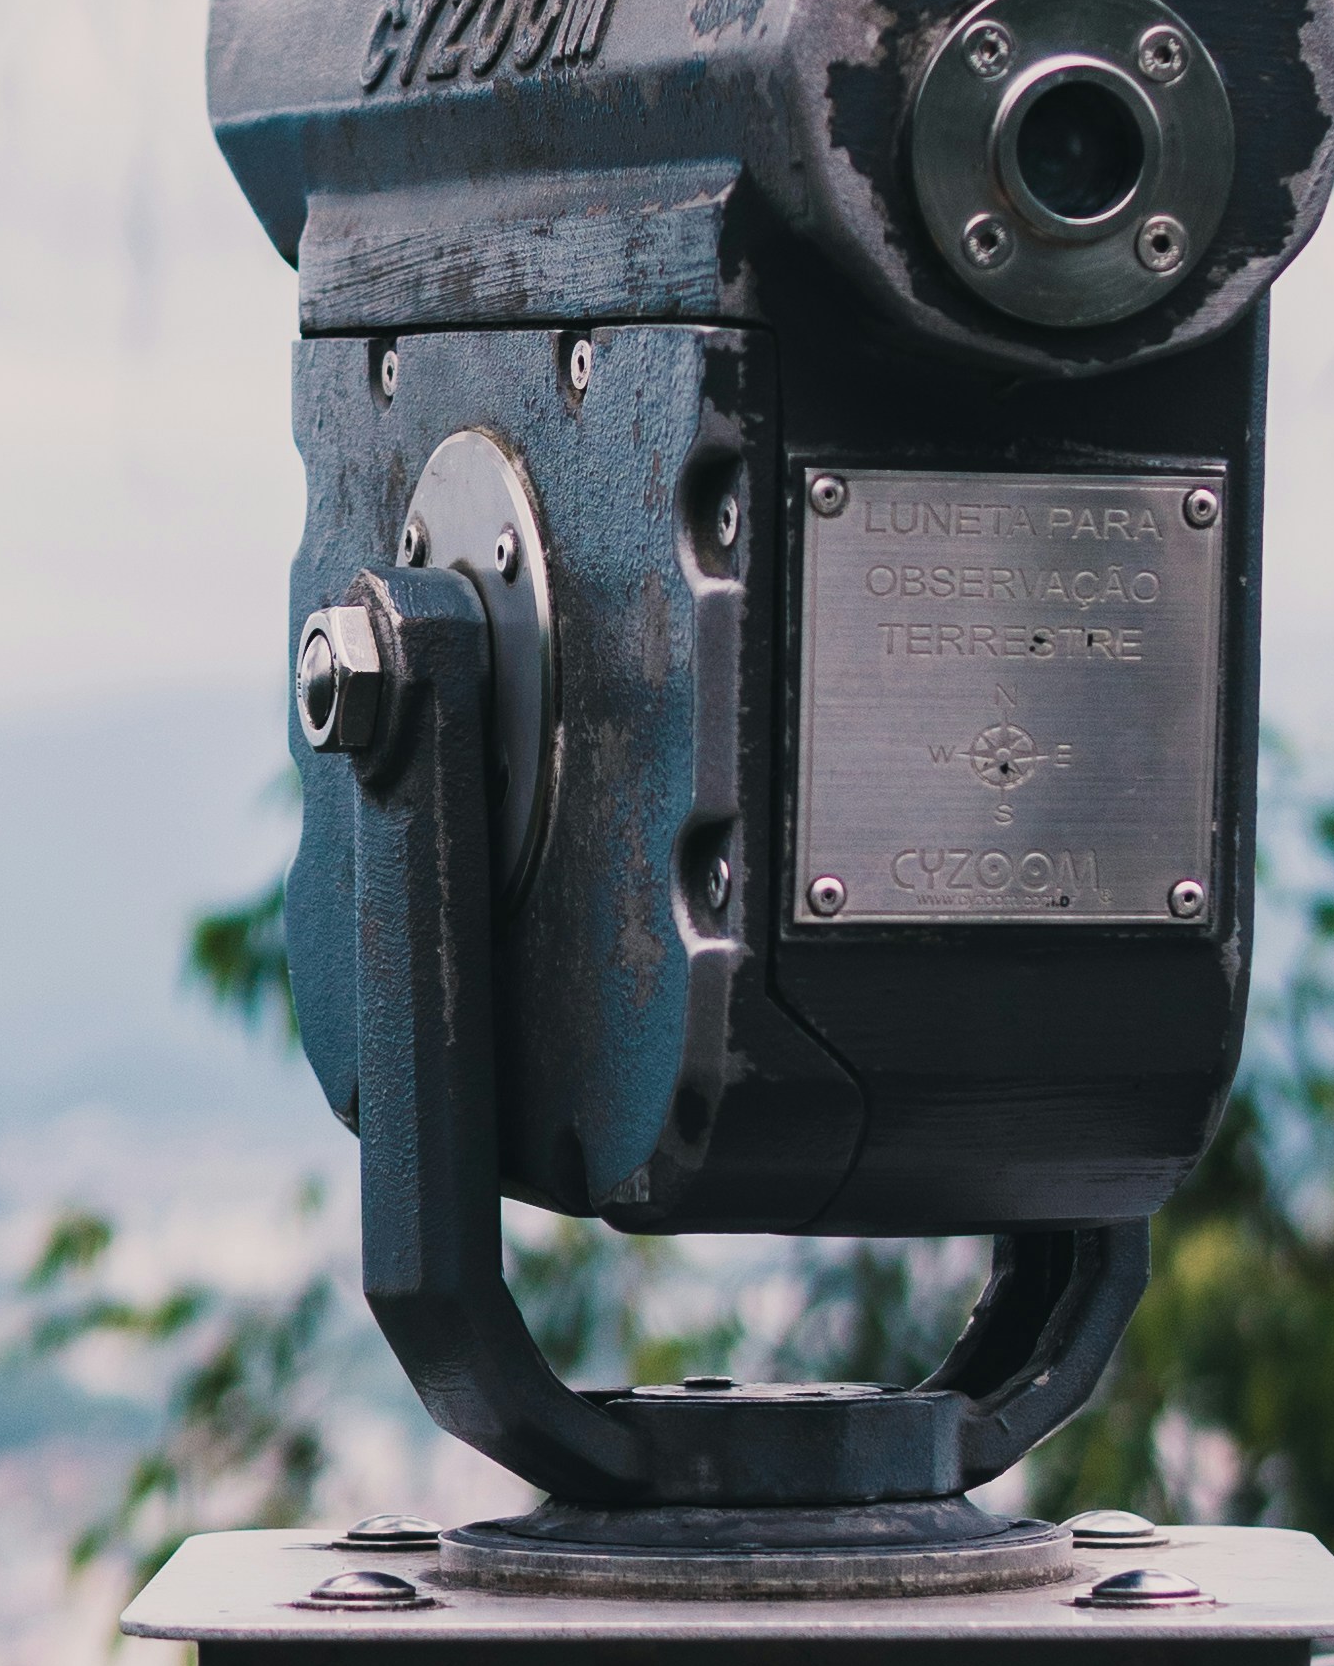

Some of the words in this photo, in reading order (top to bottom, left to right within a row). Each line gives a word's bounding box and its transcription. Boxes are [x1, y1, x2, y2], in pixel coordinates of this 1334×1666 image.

[865, 501, 1038, 536] LUNETA
[1048, 507, 1163, 541] PARA
[866, 563, 1162, 610] OBSERVAÇÃO
[877, 623, 1144, 661] TERRESTRE
[994, 683, 1018, 709] N
[928, 744, 957, 764] W
[1054, 744, 1073, 768] E
[993, 803, 1014, 826] S
[889, 848, 1101, 892] CYZOOM
